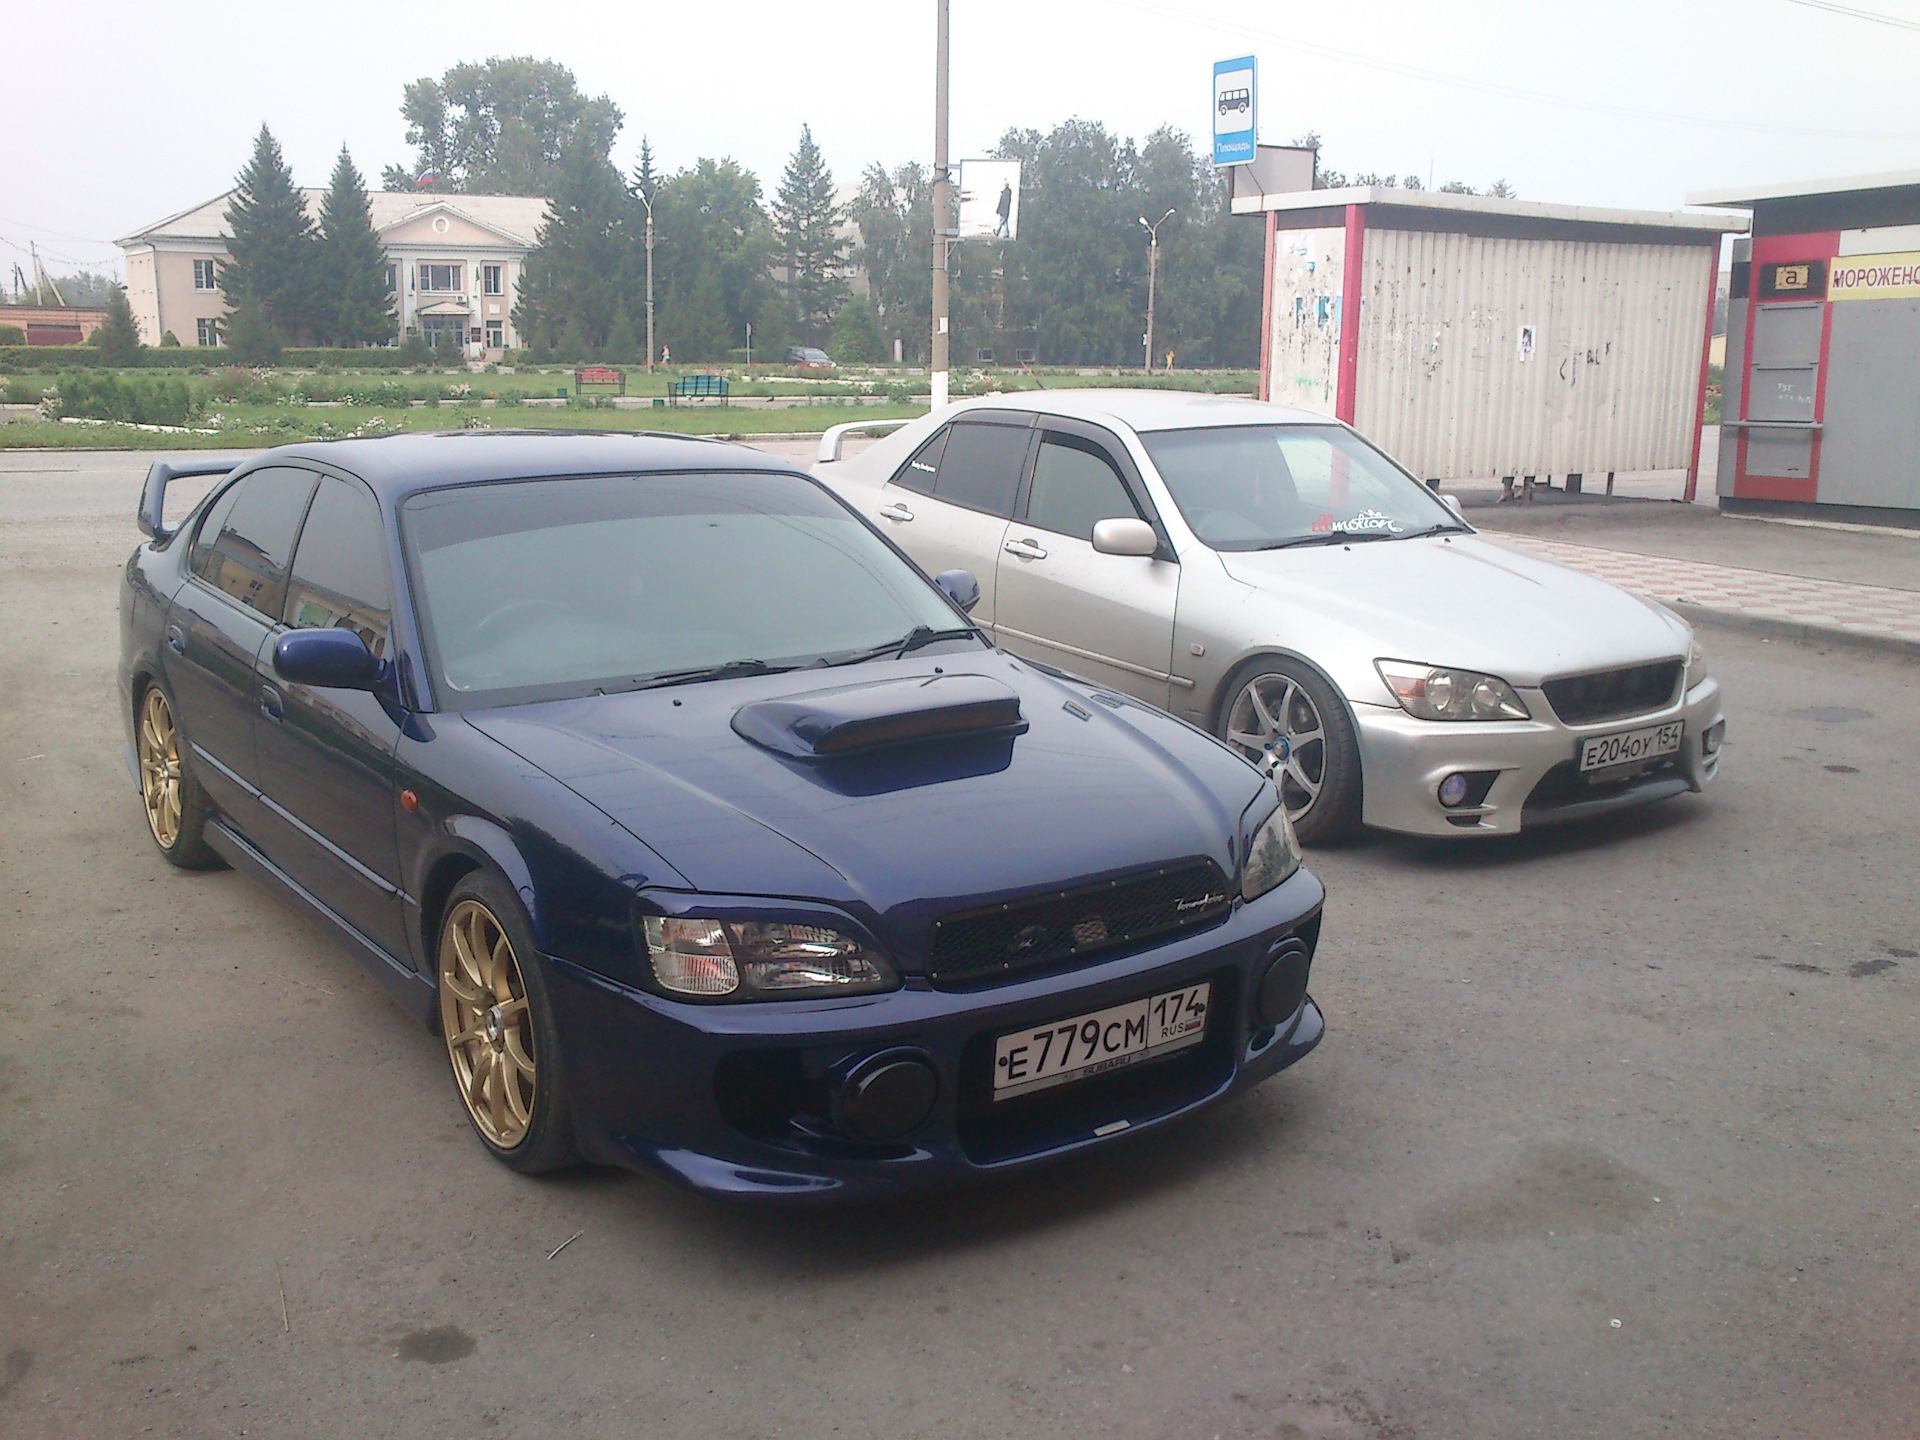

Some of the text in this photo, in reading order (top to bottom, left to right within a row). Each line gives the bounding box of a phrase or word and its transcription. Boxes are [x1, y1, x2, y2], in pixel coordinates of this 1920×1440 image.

[1216, 142, 1251, 153] Площадь
[1656, 725, 1679, 745] 154
[1154, 989, 1202, 1027] 174
[1161, 1022, 1184, 1038] RUS
[1083, 1055, 1132, 1076] SUBARU
